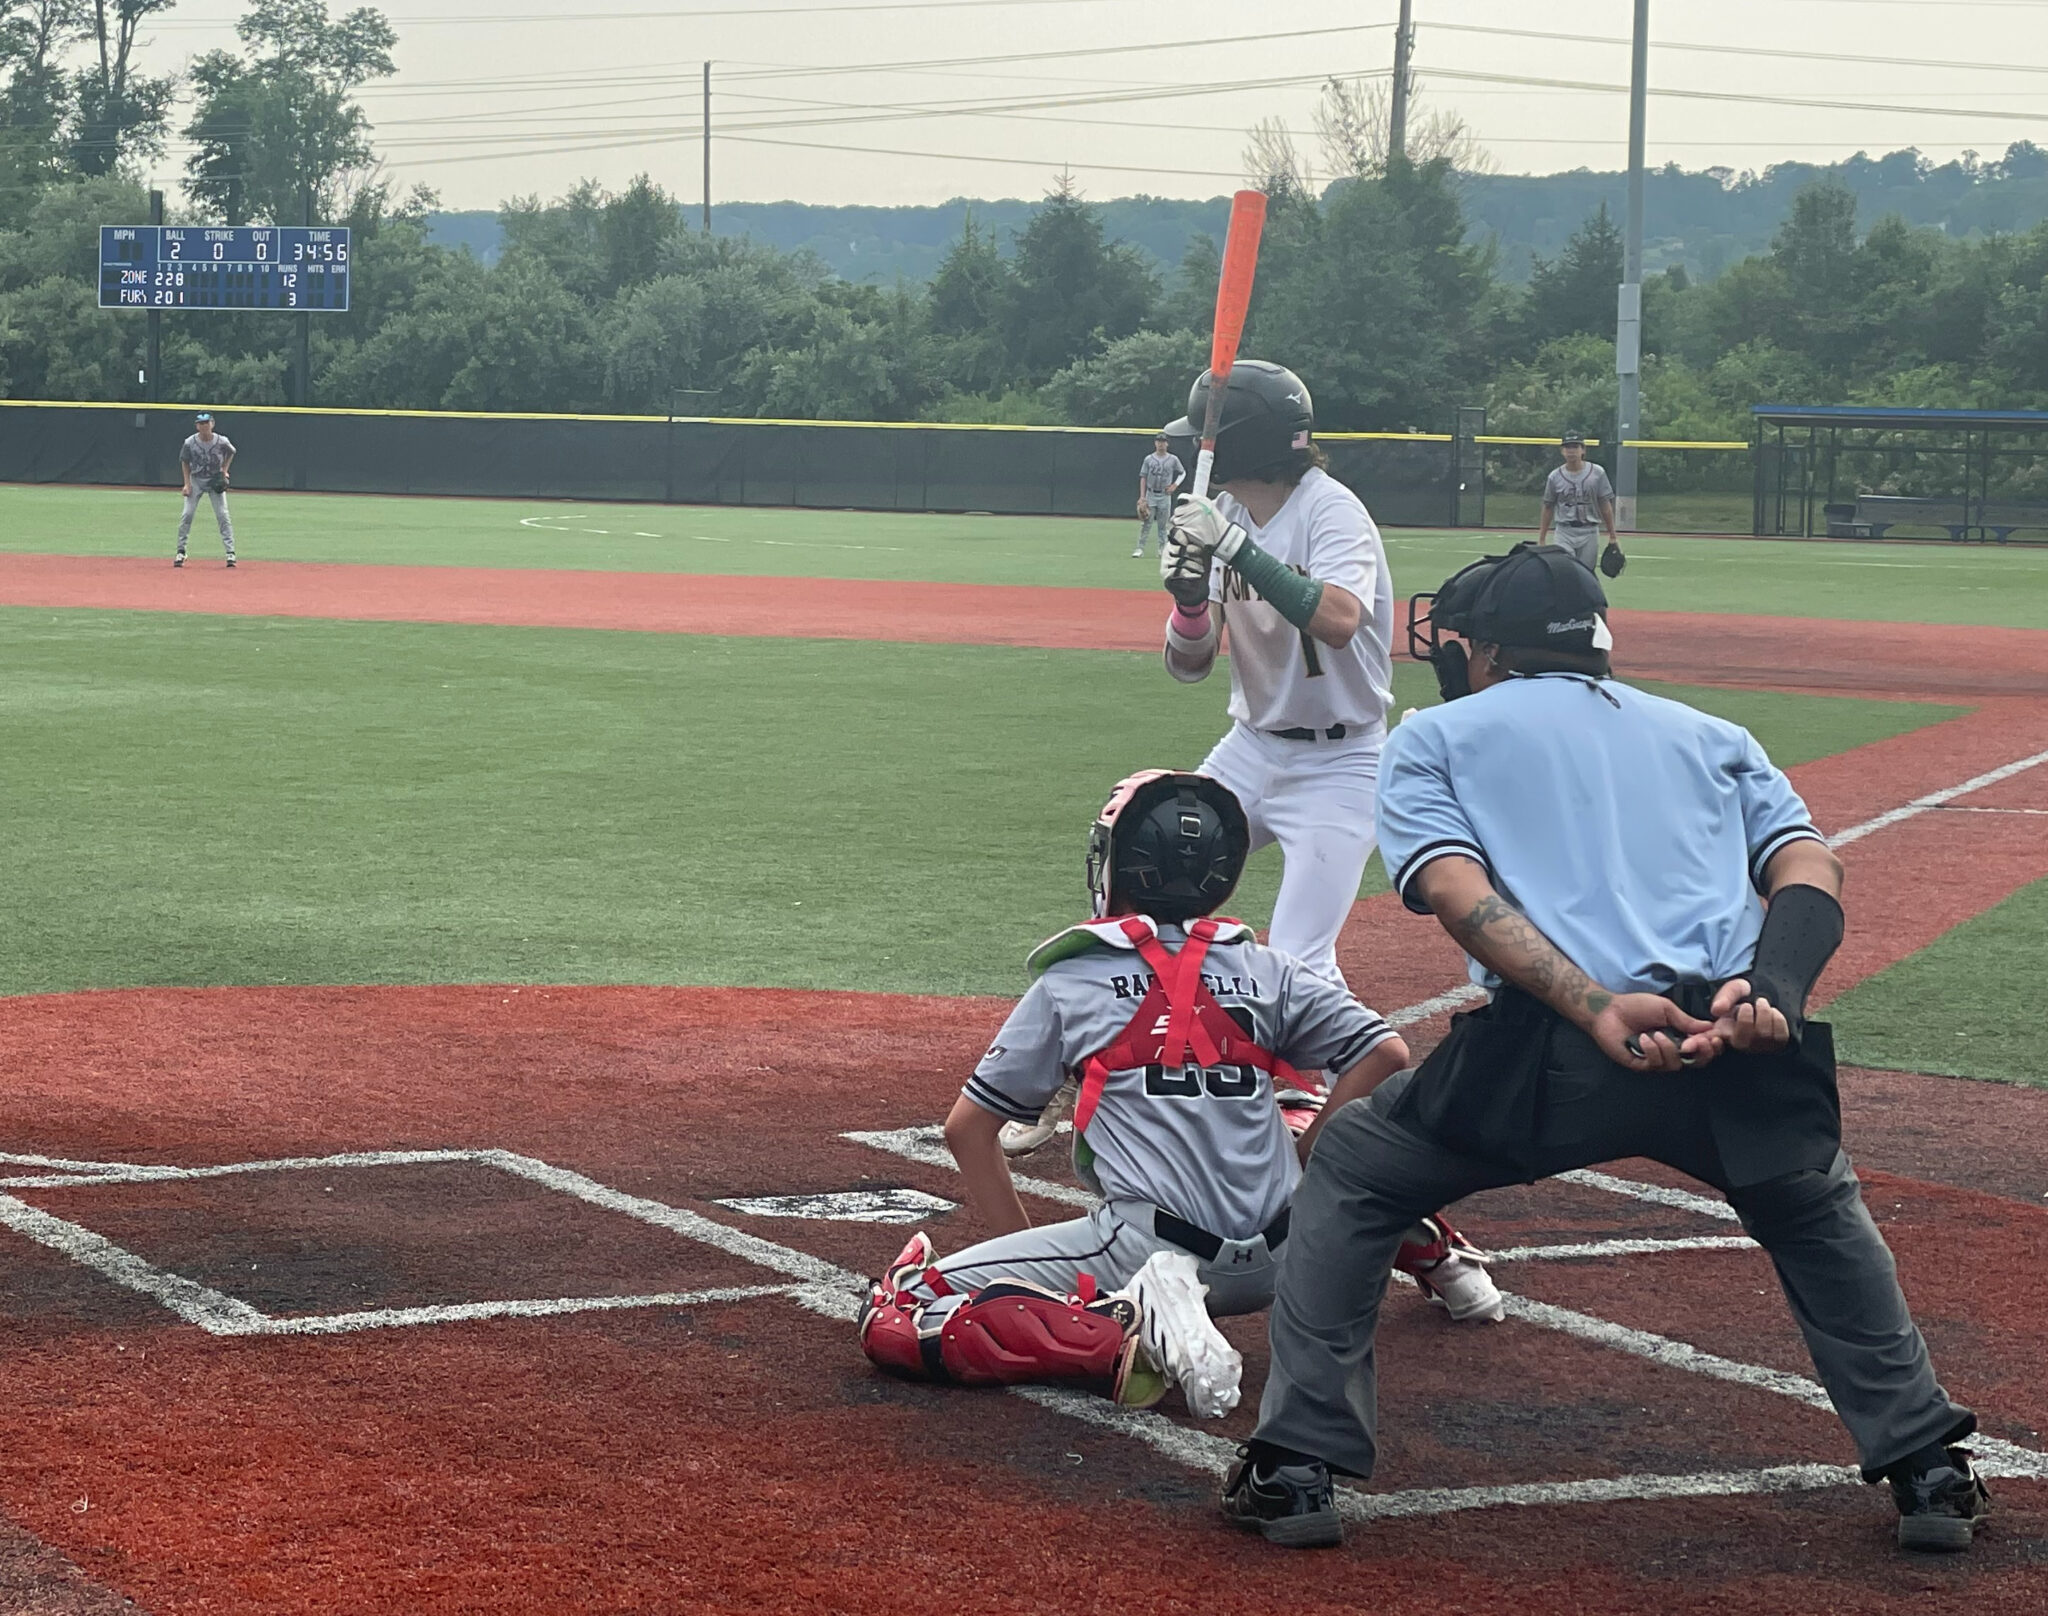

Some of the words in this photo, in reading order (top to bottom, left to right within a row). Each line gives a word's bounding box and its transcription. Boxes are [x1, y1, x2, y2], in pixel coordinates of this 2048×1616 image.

[113, 229, 136, 241] MPH
[165, 229, 186, 241] BALL
[204, 229, 234, 242] STRIKE
[252, 230, 271, 242] OUT
[308, 231, 331, 242] TIME
[170, 242, 181, 260] 2
[213, 242, 224, 260] 0
[256, 243, 267, 261] 0
[261, 264, 270, 273] 10
[277, 264, 298, 273] RUNS
[307, 264, 325, 273] HITS
[331, 265, 346, 274] ERR
[120, 270, 148, 284] ZONE
[283, 274, 297, 288] 12
[120, 288, 147, 304] FURY
[288, 292, 297, 306] 3
[1110, 973, 1262, 999] RAELLI
